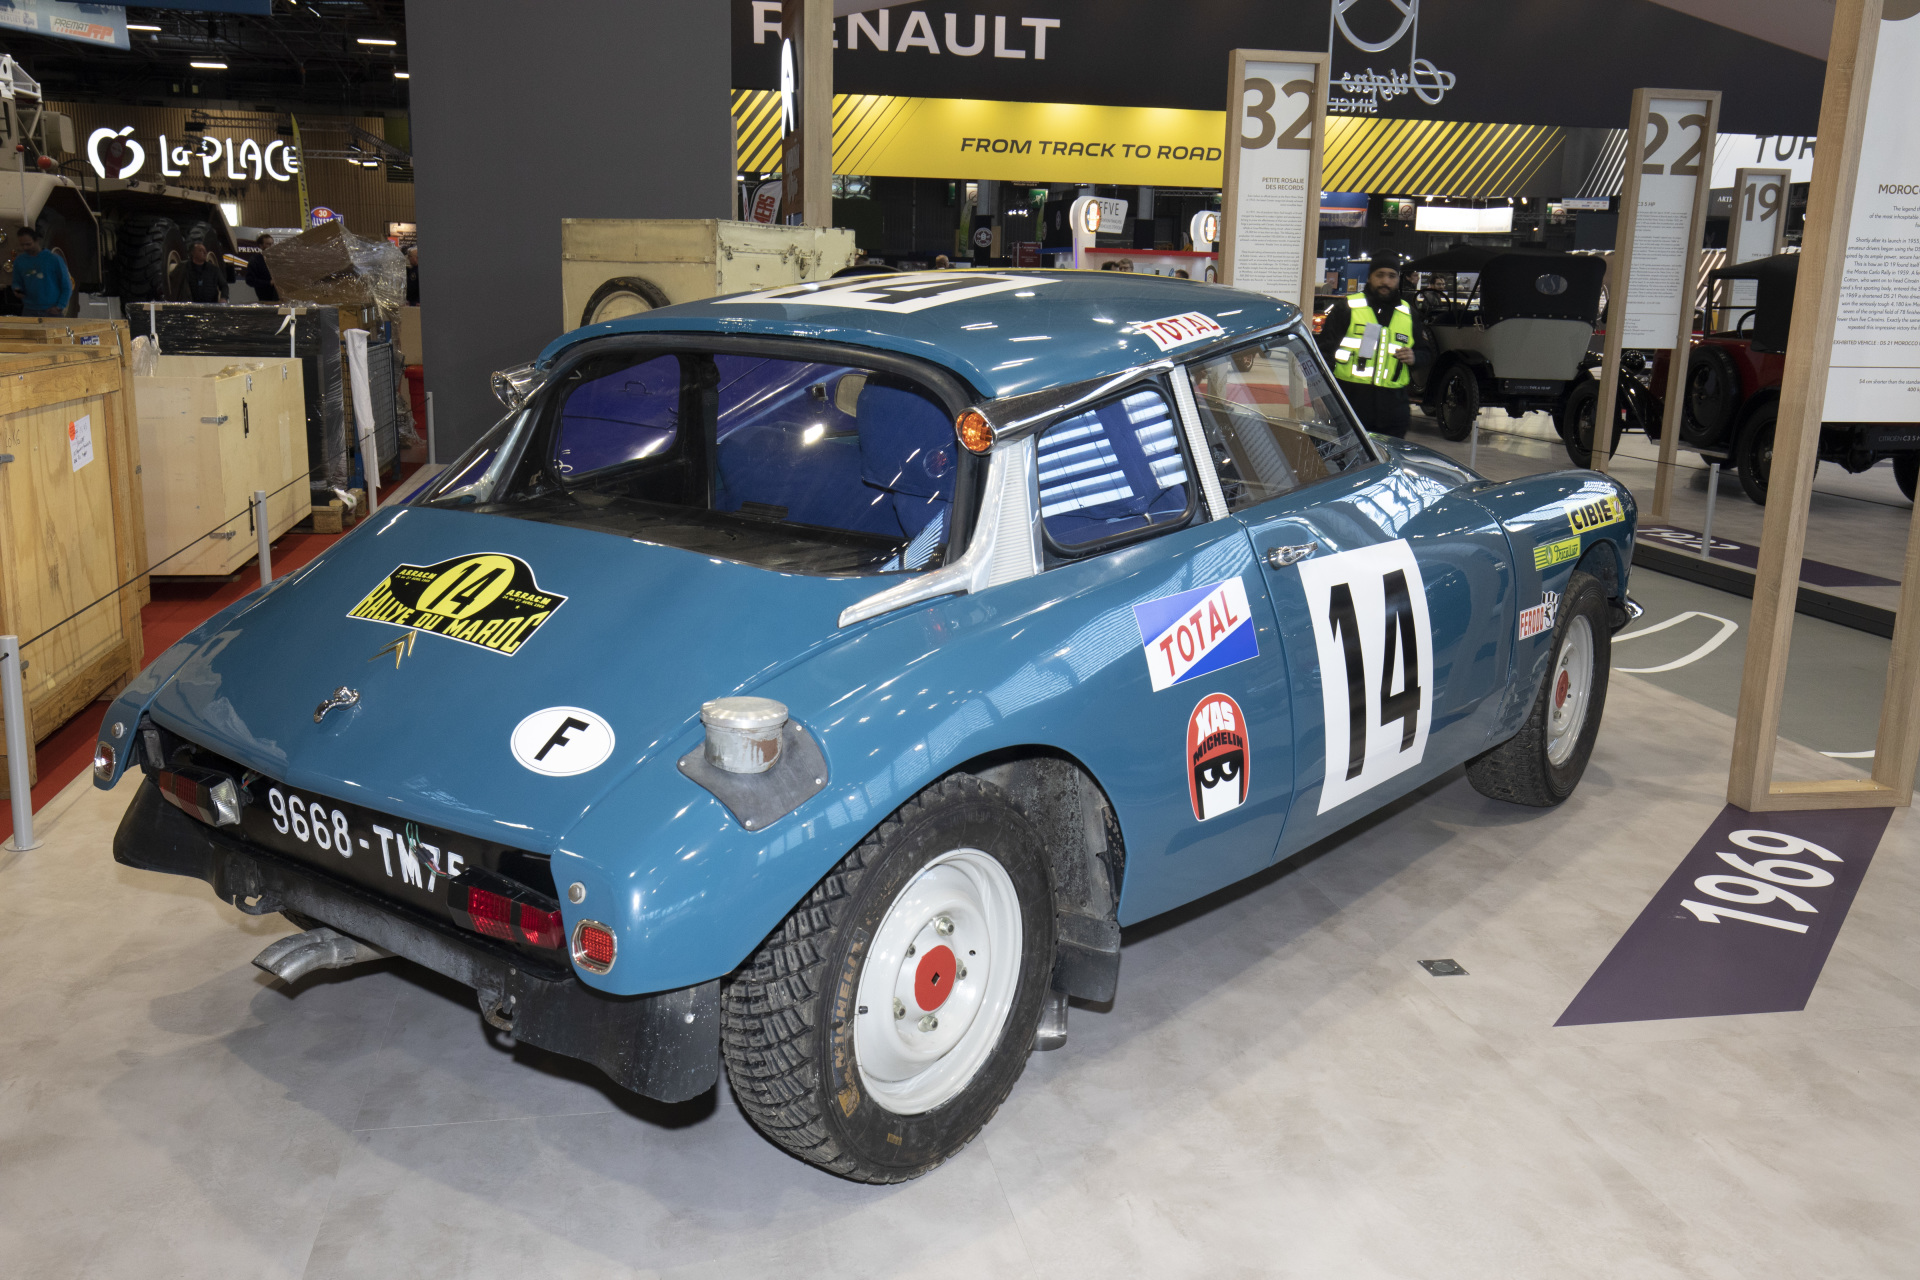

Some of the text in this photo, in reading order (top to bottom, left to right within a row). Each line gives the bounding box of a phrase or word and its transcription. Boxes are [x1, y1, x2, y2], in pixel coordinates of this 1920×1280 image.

[55, 18, 89, 32] PREMAT
[752, 0, 1061, 60] RNAULT
[1241, 77, 1315, 151] 32
[960, 137, 1223, 162] FROM TRACK TO ROAD
[1641, 111, 1708, 177] 22
[1744, 182, 1782, 222] 19
[1878, 184, 1920, 195] MOROC
[318, 209, 328, 217] 30
[1141, 311, 1220, 346] TOTAL
[1571, 498, 1614, 530] CIBIE
[425, 562, 507, 616] 14
[350, 575, 551, 654] RALLYE DU MAROC
[1159, 590, 1239, 678] TOTAL
[1519, 606, 1545, 638] FERODO
[1328, 568, 1422, 782] 14
[533, 716, 590, 762] F
[1195, 701, 1236, 746] XAS
[1192, 731, 1244, 767] MICHELIN
[1680, 829, 1845, 934] 1969
